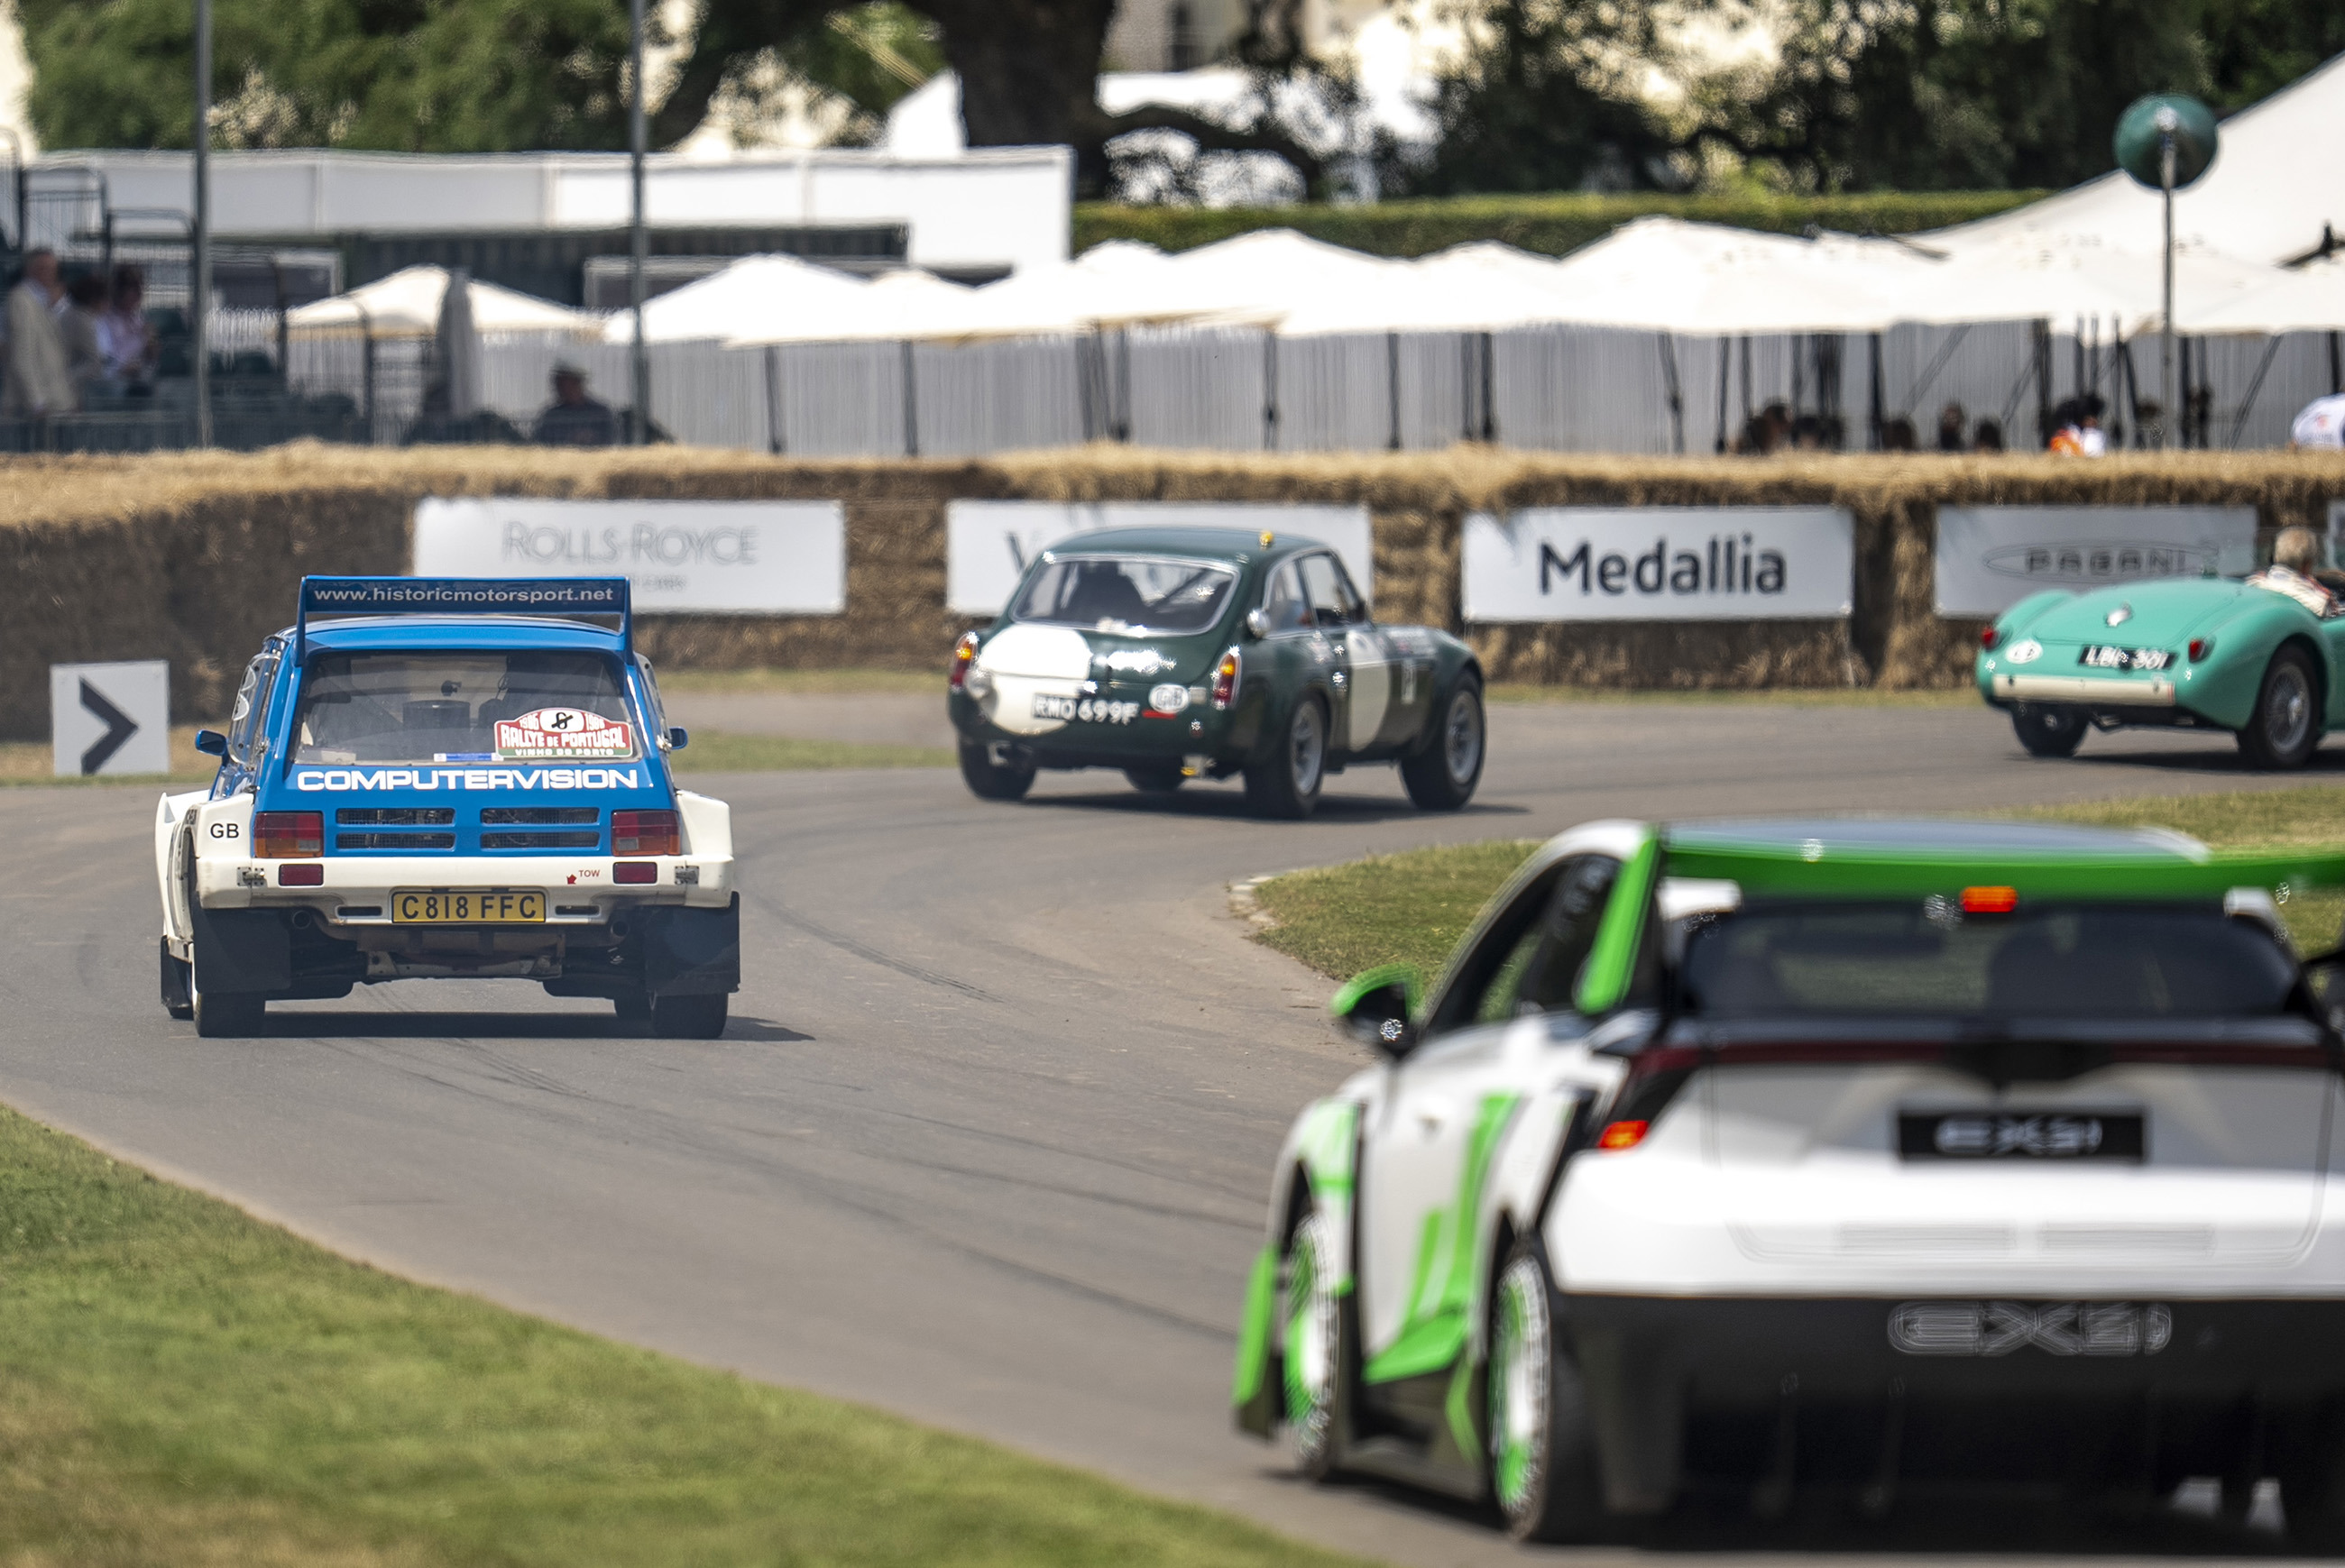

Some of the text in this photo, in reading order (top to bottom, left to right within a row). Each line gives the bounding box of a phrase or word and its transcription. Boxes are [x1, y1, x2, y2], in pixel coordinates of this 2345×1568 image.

[1538, 532, 1787, 597] Medallia
[315, 587, 613, 604] www.historicmotorsport.net
[501, 724, 627, 747] RALLYE DE PORTUGAL
[297, 769, 638, 791] COMPUTERVISION
[210, 823, 239, 839] GB
[579, 869, 601, 877] TOW
[401, 895, 537, 920] C818 FFC
